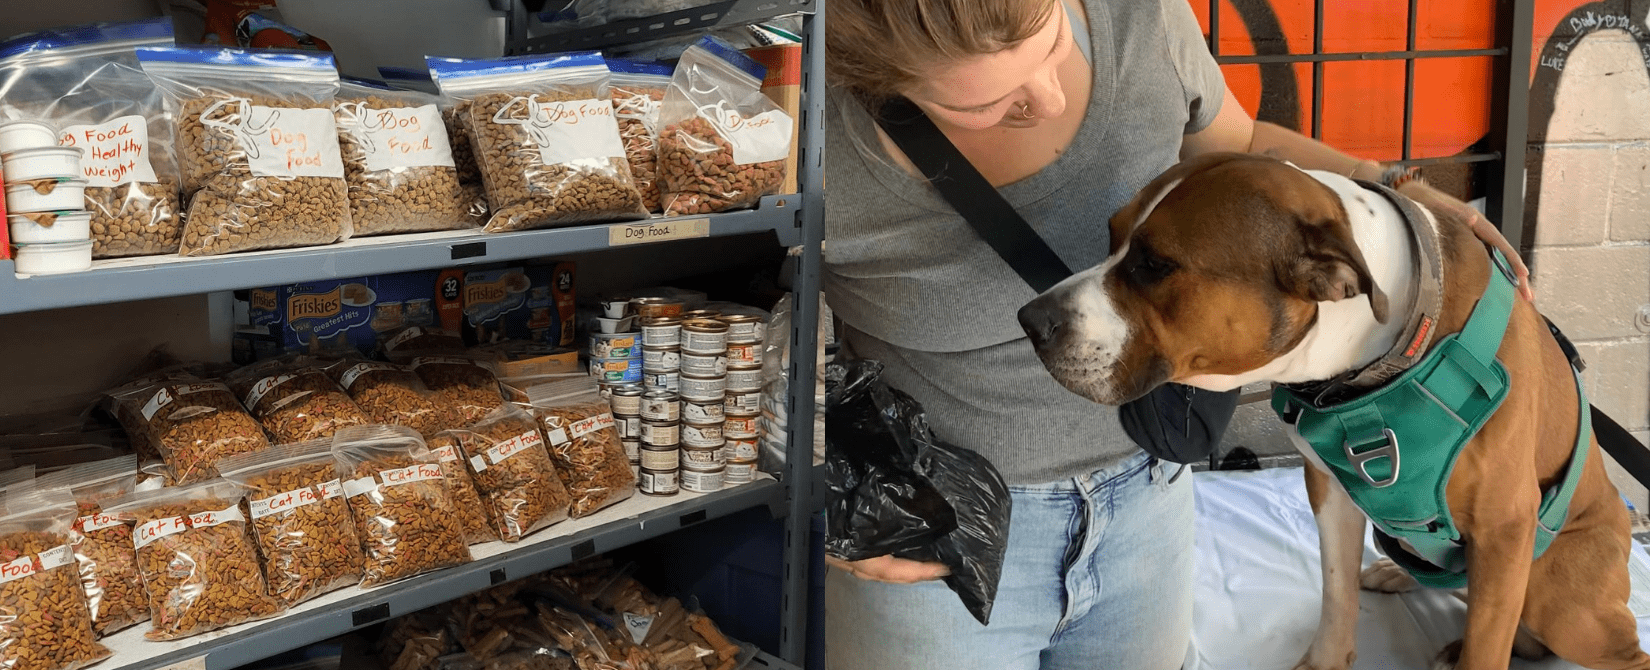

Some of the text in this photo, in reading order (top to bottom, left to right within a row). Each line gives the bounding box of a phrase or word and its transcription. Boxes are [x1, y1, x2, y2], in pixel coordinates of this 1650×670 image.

[376, 111, 421, 133] Dog
[541, 104, 611, 125] Dog Food
[85, 122, 133, 143] Food
[269, 128, 308, 153] Dog
[92, 138, 143, 161] Healthy
[387, 134, 433, 155] Food
[286, 149, 322, 171] Food
[84, 160, 136, 183] Weight
[625, 225, 671, 239] Dog Food
[445, 279, 458, 292] 32
[559, 271, 570, 285] 24
[469, 285, 505, 304] Friskies
[292, 297, 338, 317] Friskies
[313, 314, 344, 333] Greatest
[257, 374, 279, 395] Cat
[573, 419, 596, 434] Cat
[499, 438, 517, 456] Cat
[388, 469, 415, 483] Cat
[418, 463, 443, 478] Food
[269, 485, 330, 510] Cat Food
[141, 519, 167, 541] Cat
[174, 513, 215, 530] Food
[1, 557, 41, 578] Food
